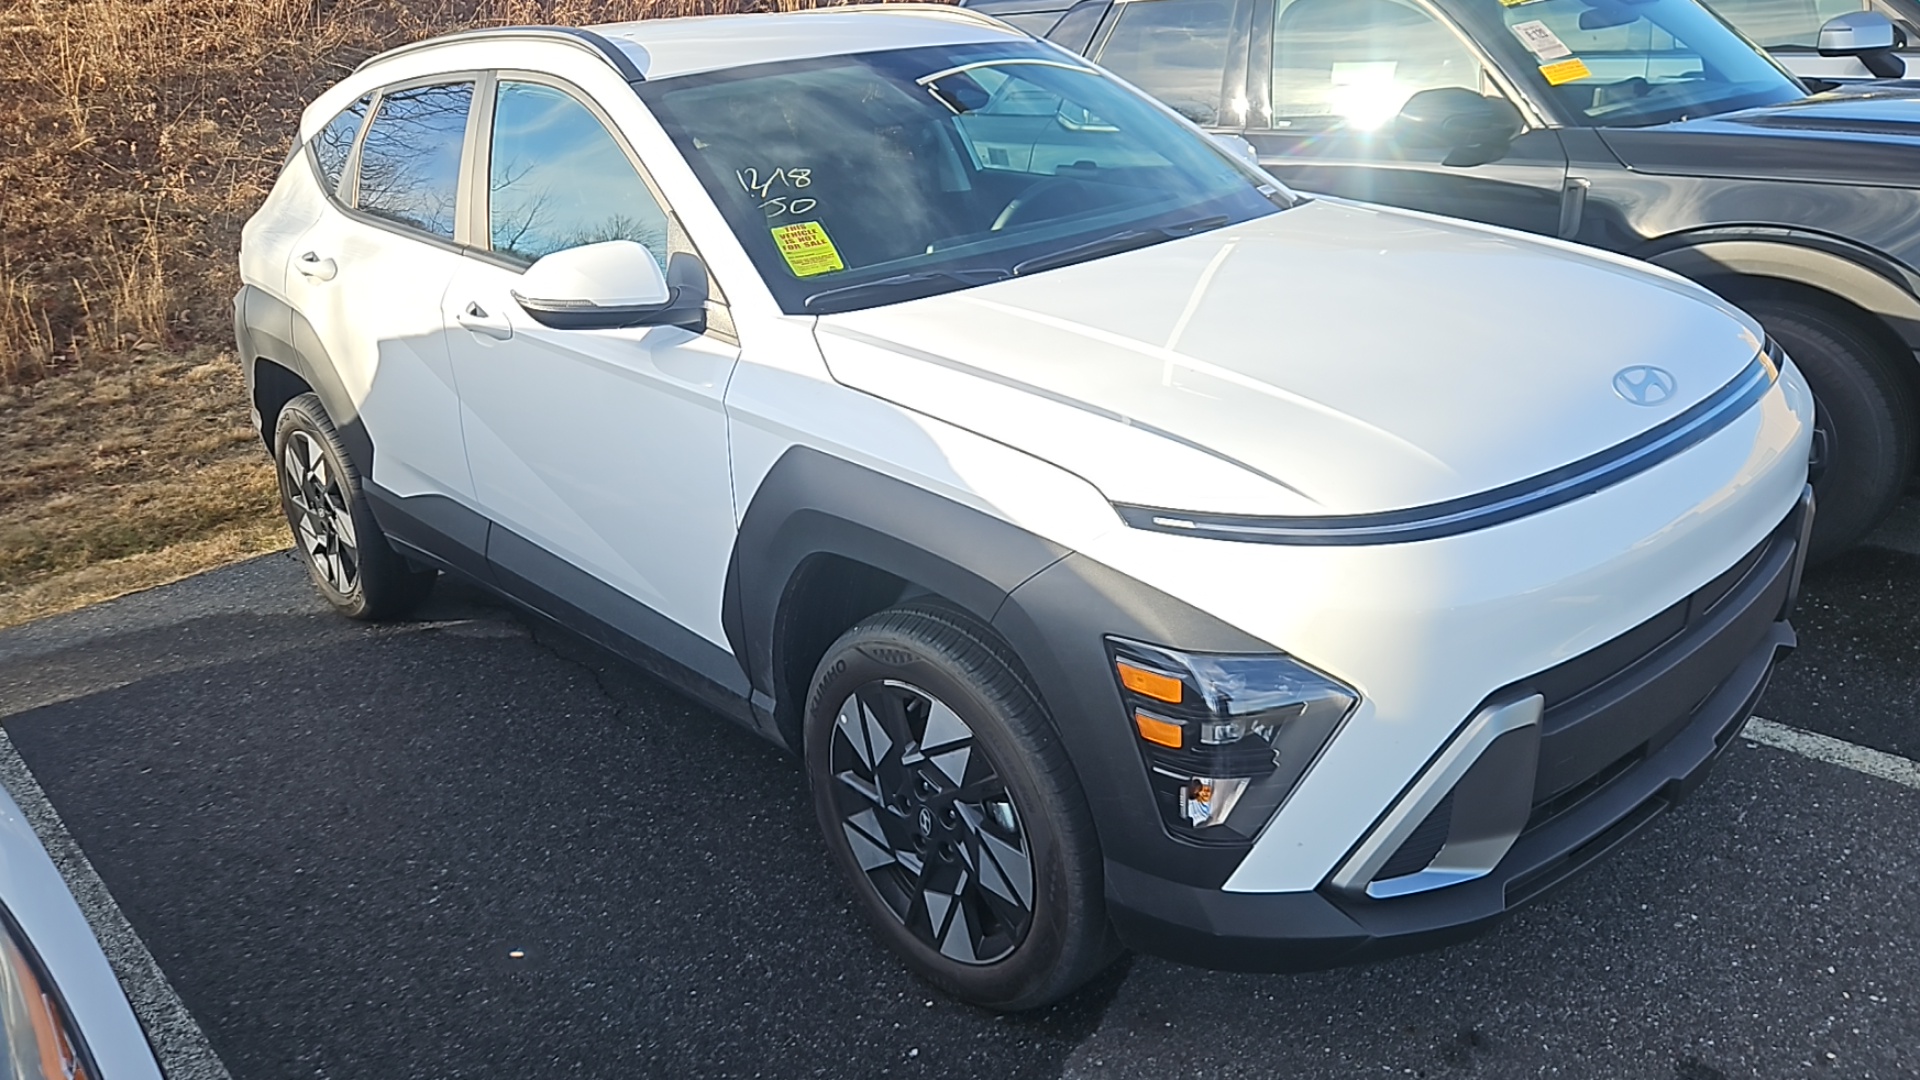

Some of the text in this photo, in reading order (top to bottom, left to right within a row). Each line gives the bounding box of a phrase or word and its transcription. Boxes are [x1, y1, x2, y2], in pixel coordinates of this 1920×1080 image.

[736, 168, 812, 198] 12/18
[784, 224, 807, 232] THIS
[779, 229, 818, 240] VEHICLE
[797, 235, 817, 243] NOT
[782, 239, 828, 251] FOR SALE
[810, 659, 847, 719] KUMHO
